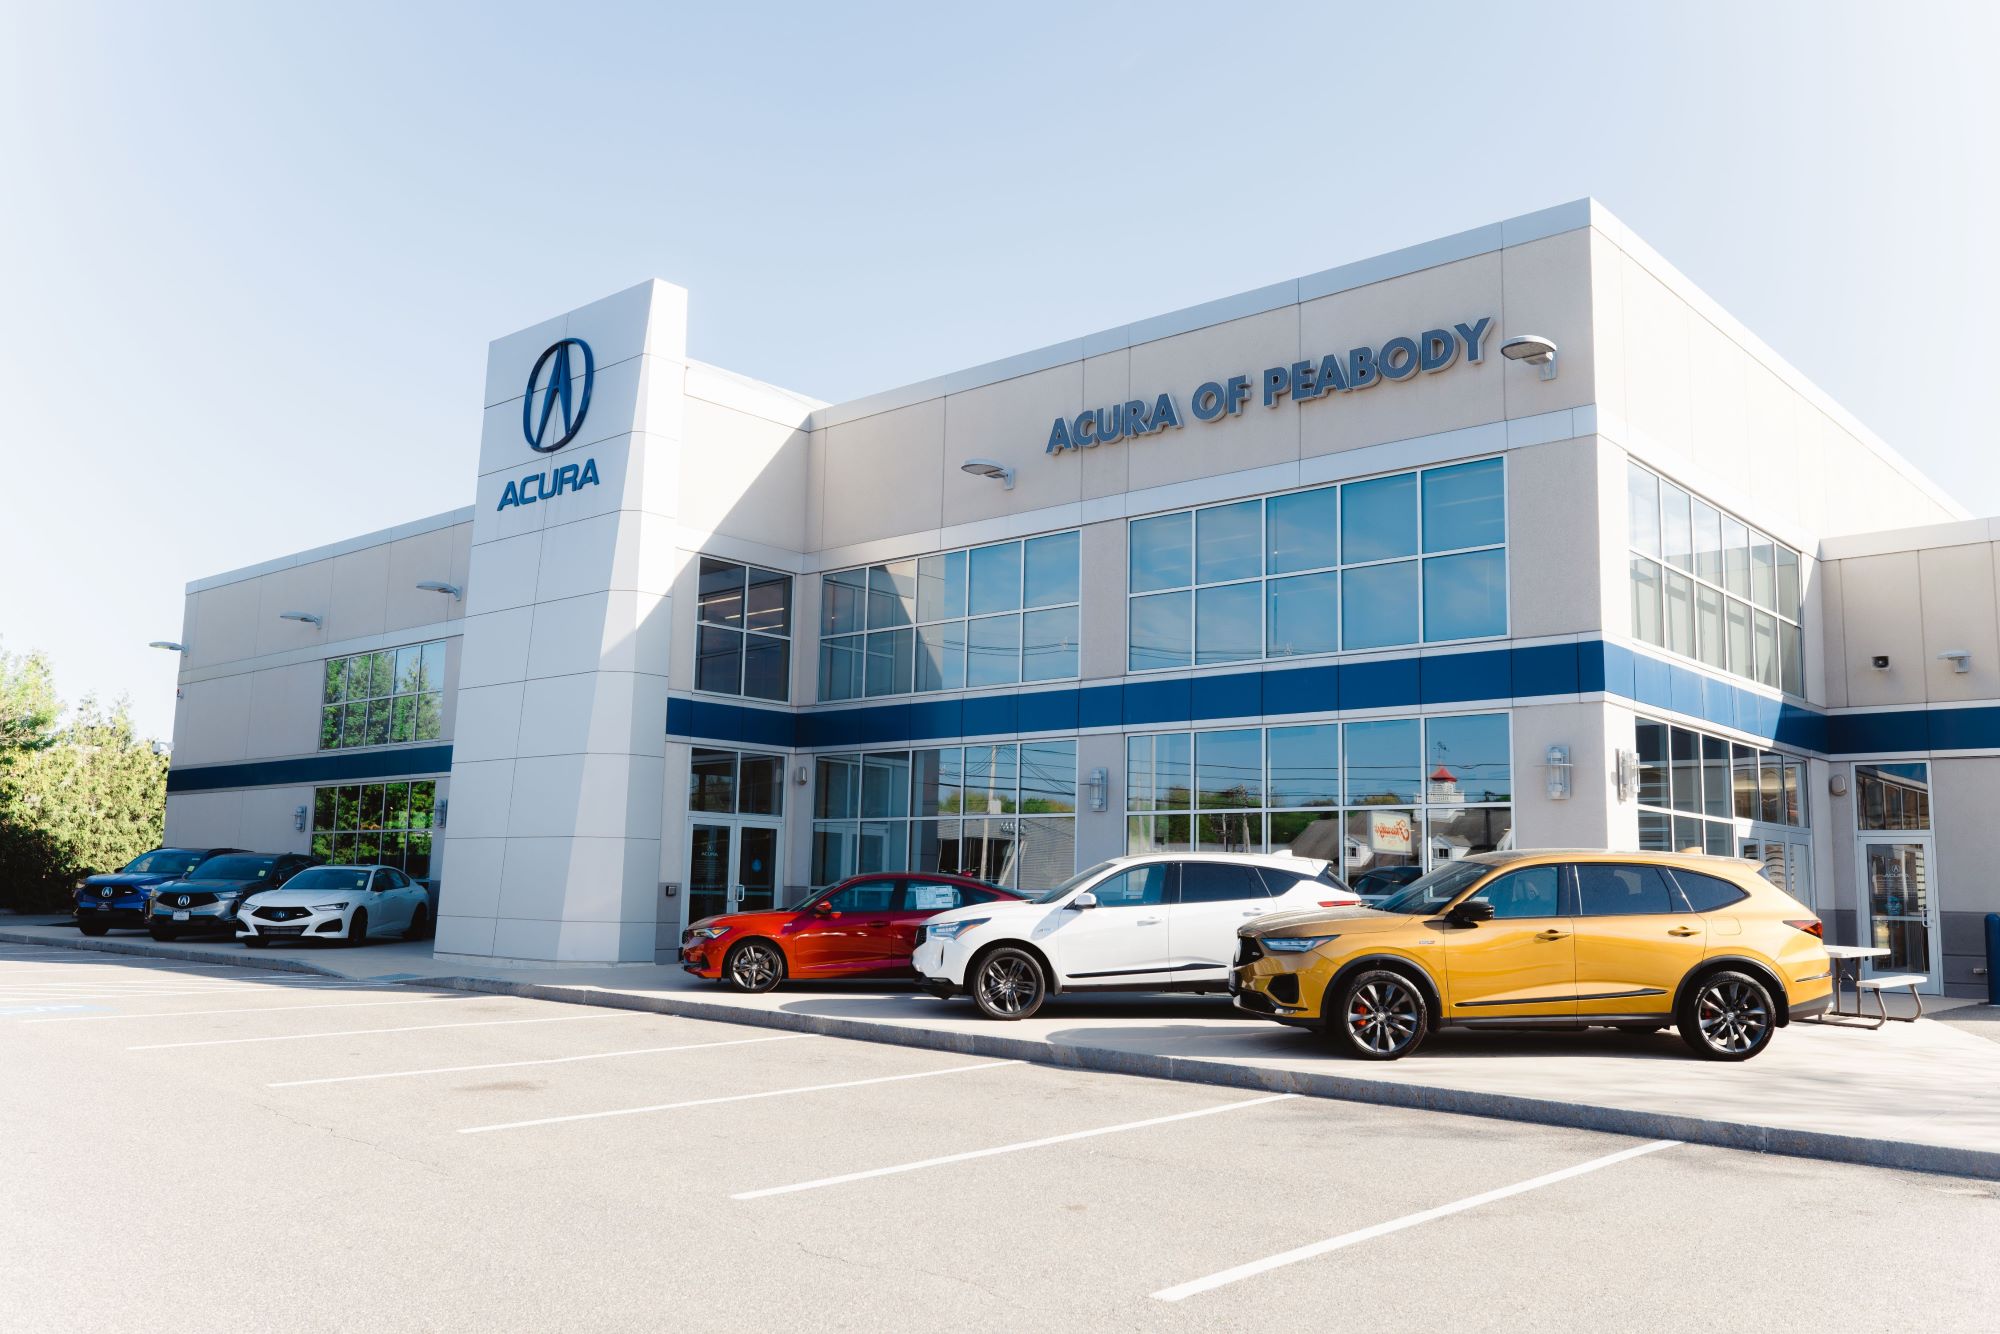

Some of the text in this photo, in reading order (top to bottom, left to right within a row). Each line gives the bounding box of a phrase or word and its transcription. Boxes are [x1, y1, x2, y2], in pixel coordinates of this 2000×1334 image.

[1046, 317, 1494, 456] ACURA OF PEABODY
[497, 458, 600, 511] ACURA
